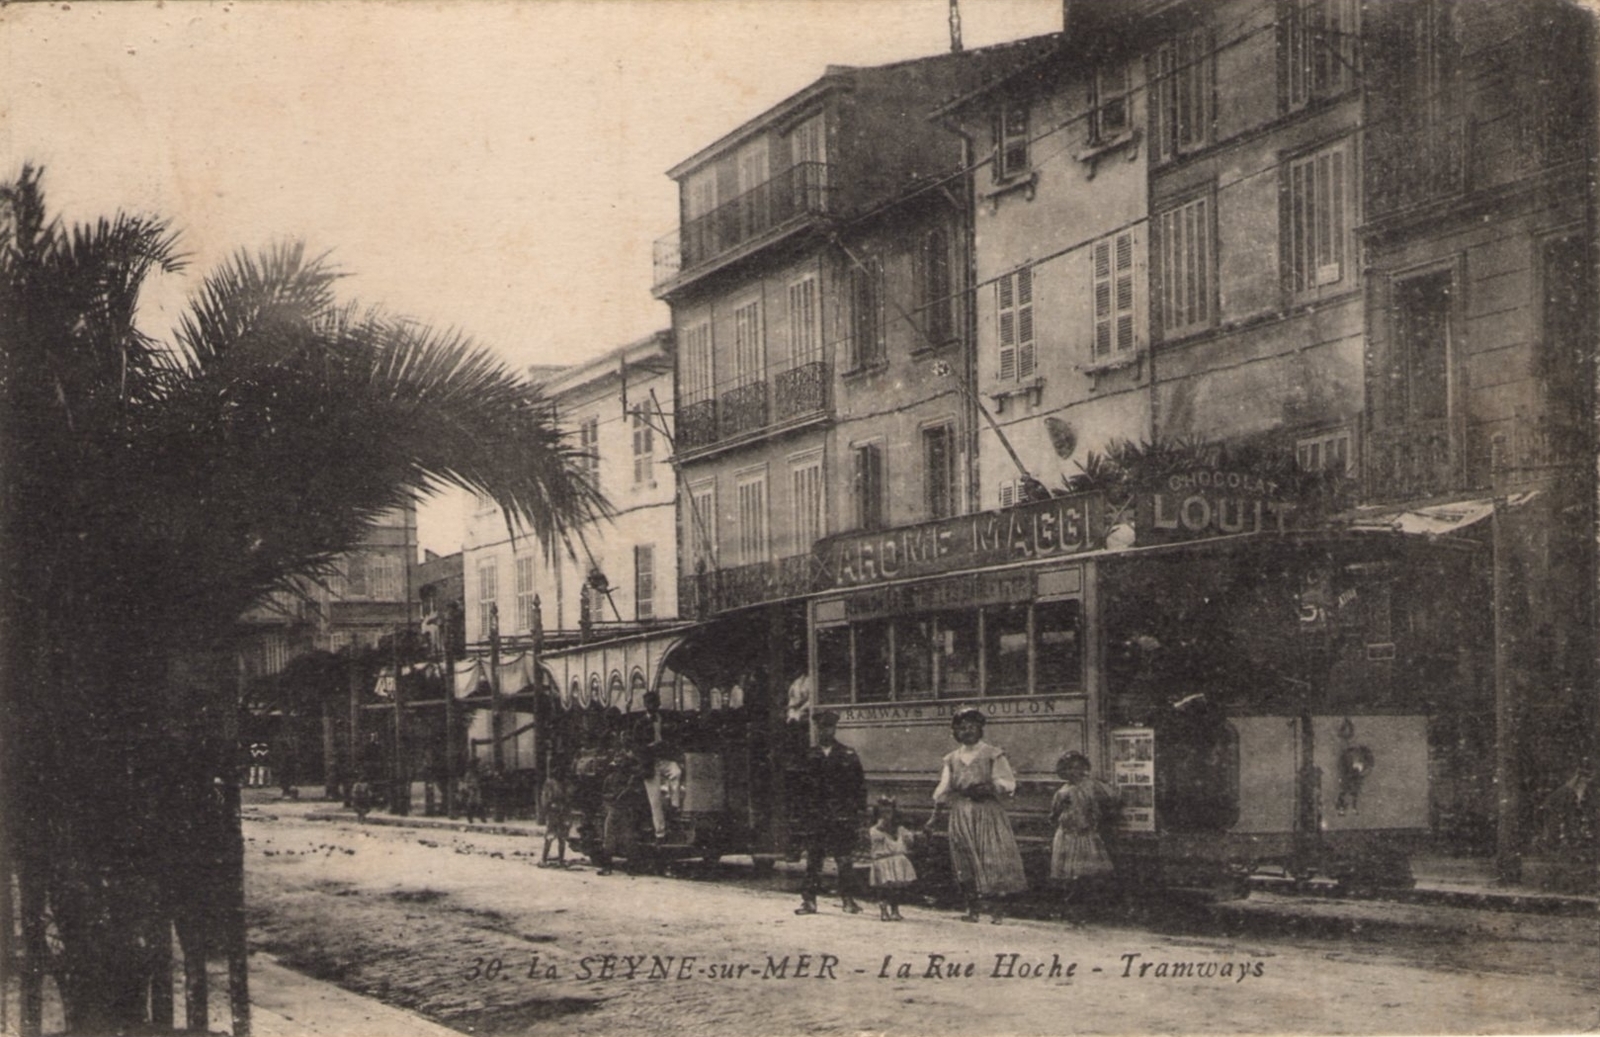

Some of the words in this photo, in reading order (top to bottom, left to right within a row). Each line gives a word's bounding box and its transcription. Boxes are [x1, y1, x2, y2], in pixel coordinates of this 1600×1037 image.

[1169, 471, 1279, 495] CHOCOLAT
[1154, 494, 1298, 537] LOUIT
[836, 526, 953, 585] AROME
[972, 501, 1094, 557] MAGGI
[838, 707, 923, 720] RAMWAYS
[974, 701, 1056, 715] OULON
